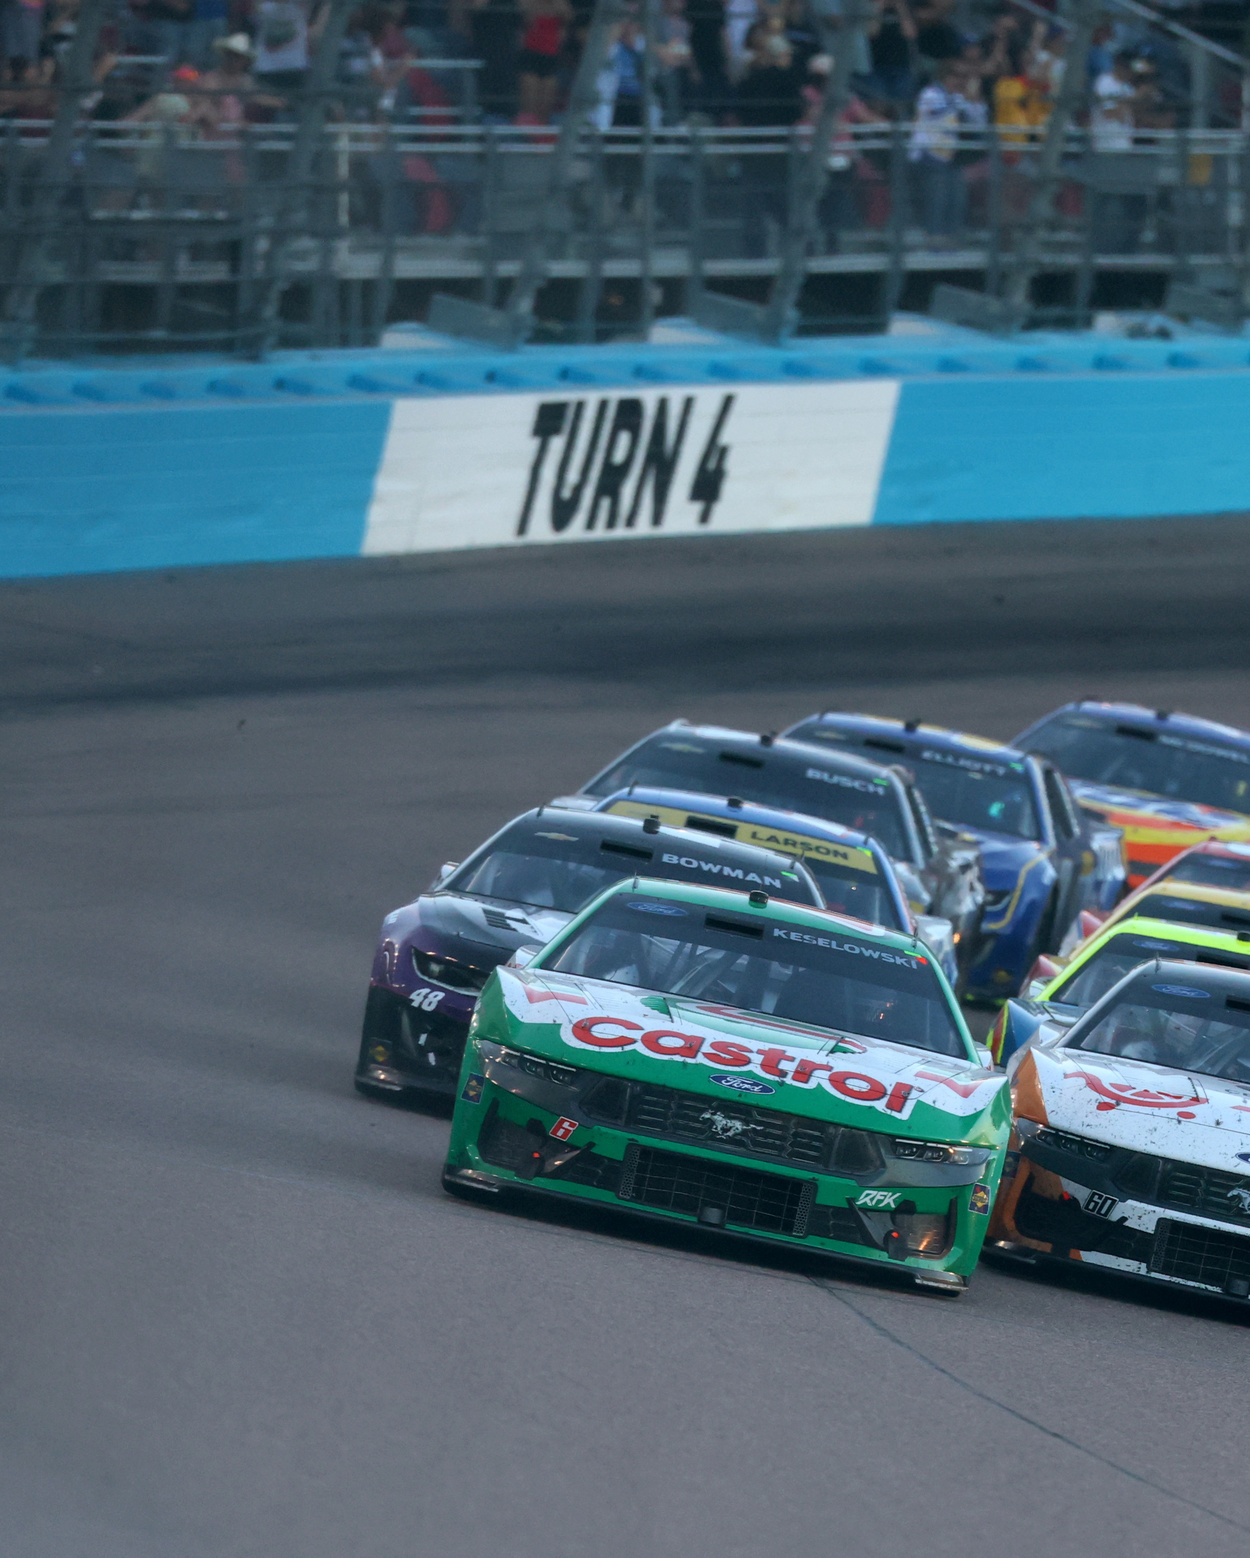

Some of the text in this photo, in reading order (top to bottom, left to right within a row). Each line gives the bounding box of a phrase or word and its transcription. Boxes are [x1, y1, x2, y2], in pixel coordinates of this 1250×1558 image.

[515, 393, 738, 538] TURN 4
[805, 767, 886, 796] BUSCH
[750, 830, 849, 861] LARSON
[661, 852, 782, 889] BOWMAN
[772, 927, 918, 970] KESELOWSKI
[409, 988, 445, 1012] 48
[571, 1016, 914, 1113] Castrol
[719, 1075, 765, 1092] Ford
[549, 1116, 579, 1141] 6
[856, 1189, 902, 1209] RFK
[1082, 1189, 1120, 1219] 60
